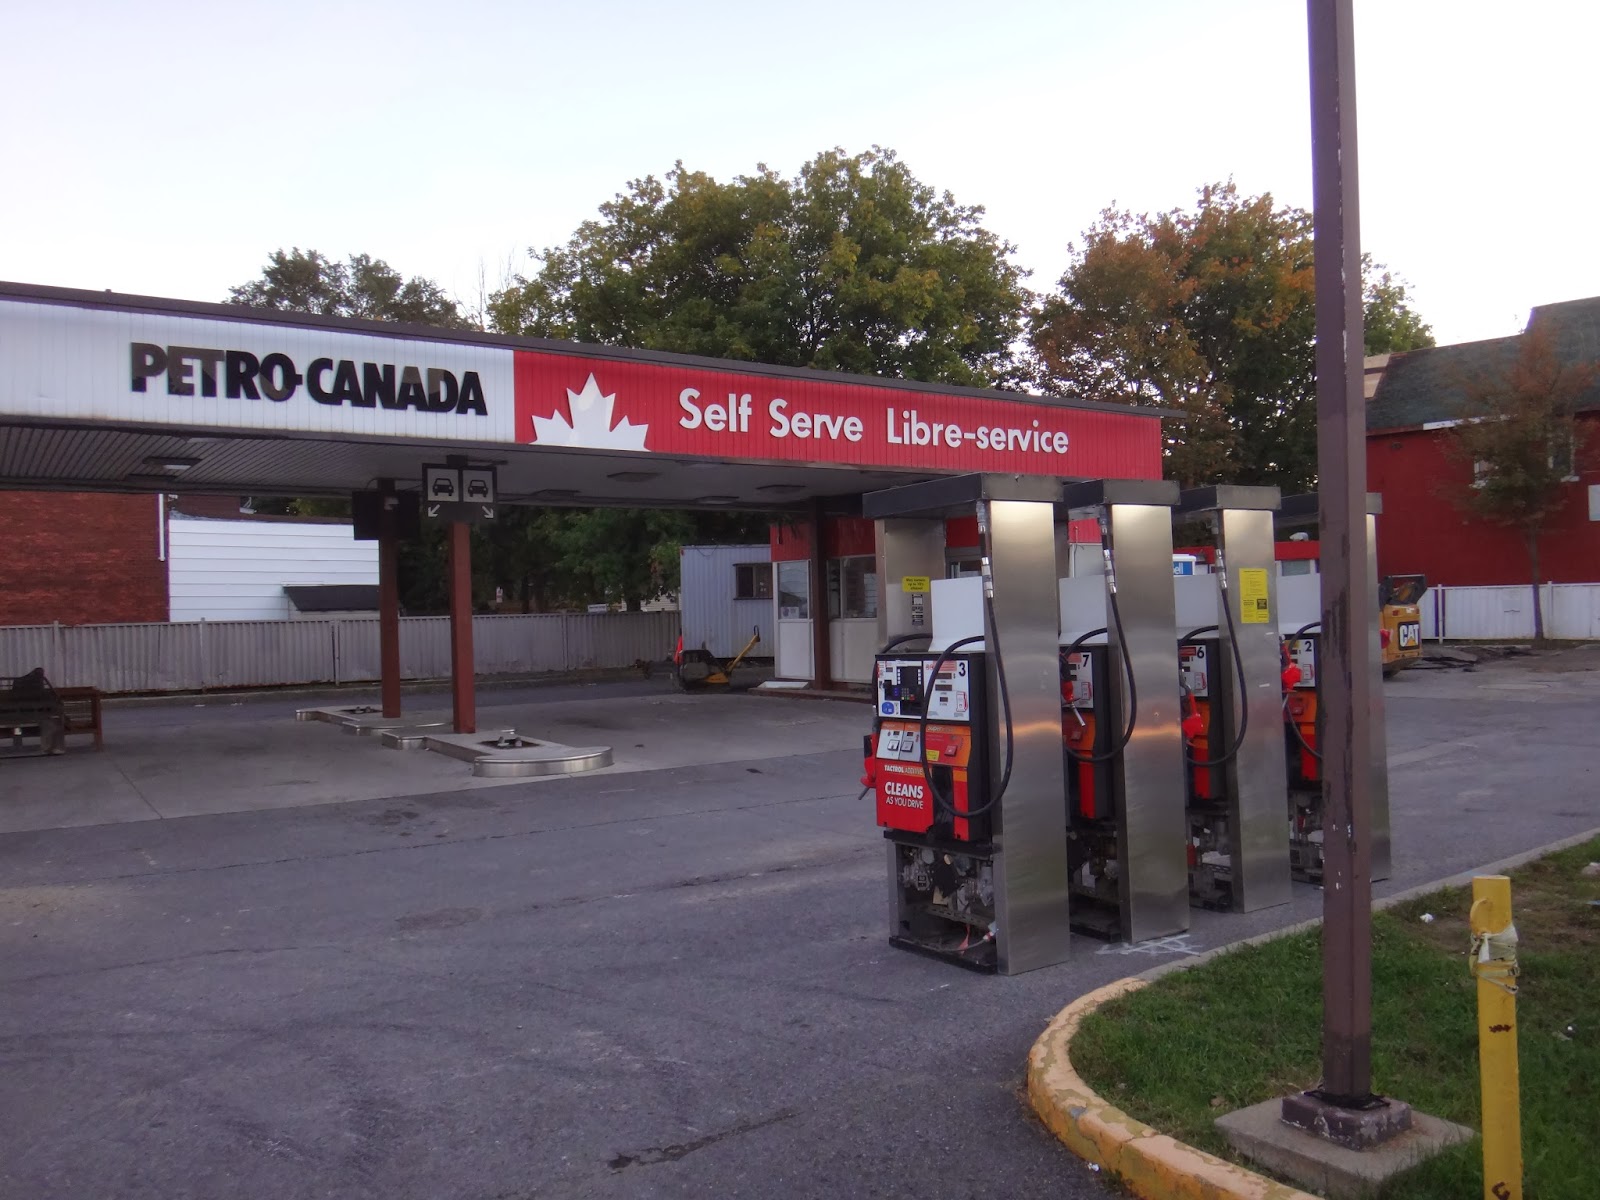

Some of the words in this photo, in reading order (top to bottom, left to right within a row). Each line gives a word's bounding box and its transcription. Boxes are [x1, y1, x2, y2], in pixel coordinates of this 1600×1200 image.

[131, 342, 488, 416] PETRO-CANADA
[678, 387, 753, 433] Self
[768, 398, 864, 442] Serve
[886, 407, 1069, 454] Libre-service
[1399, 624, 1419, 647] CAT
[1196, 646, 1205, 659] 6
[1305, 640, 1312, 652] 2
[1082, 654, 1090, 668] 7
[958, 662, 966, 677] 3
[885, 781, 923, 799] CLEANS
[885, 796, 894, 805] AS
[895, 797, 907, 807] YOU
[907, 799, 923, 810] DRIVE
